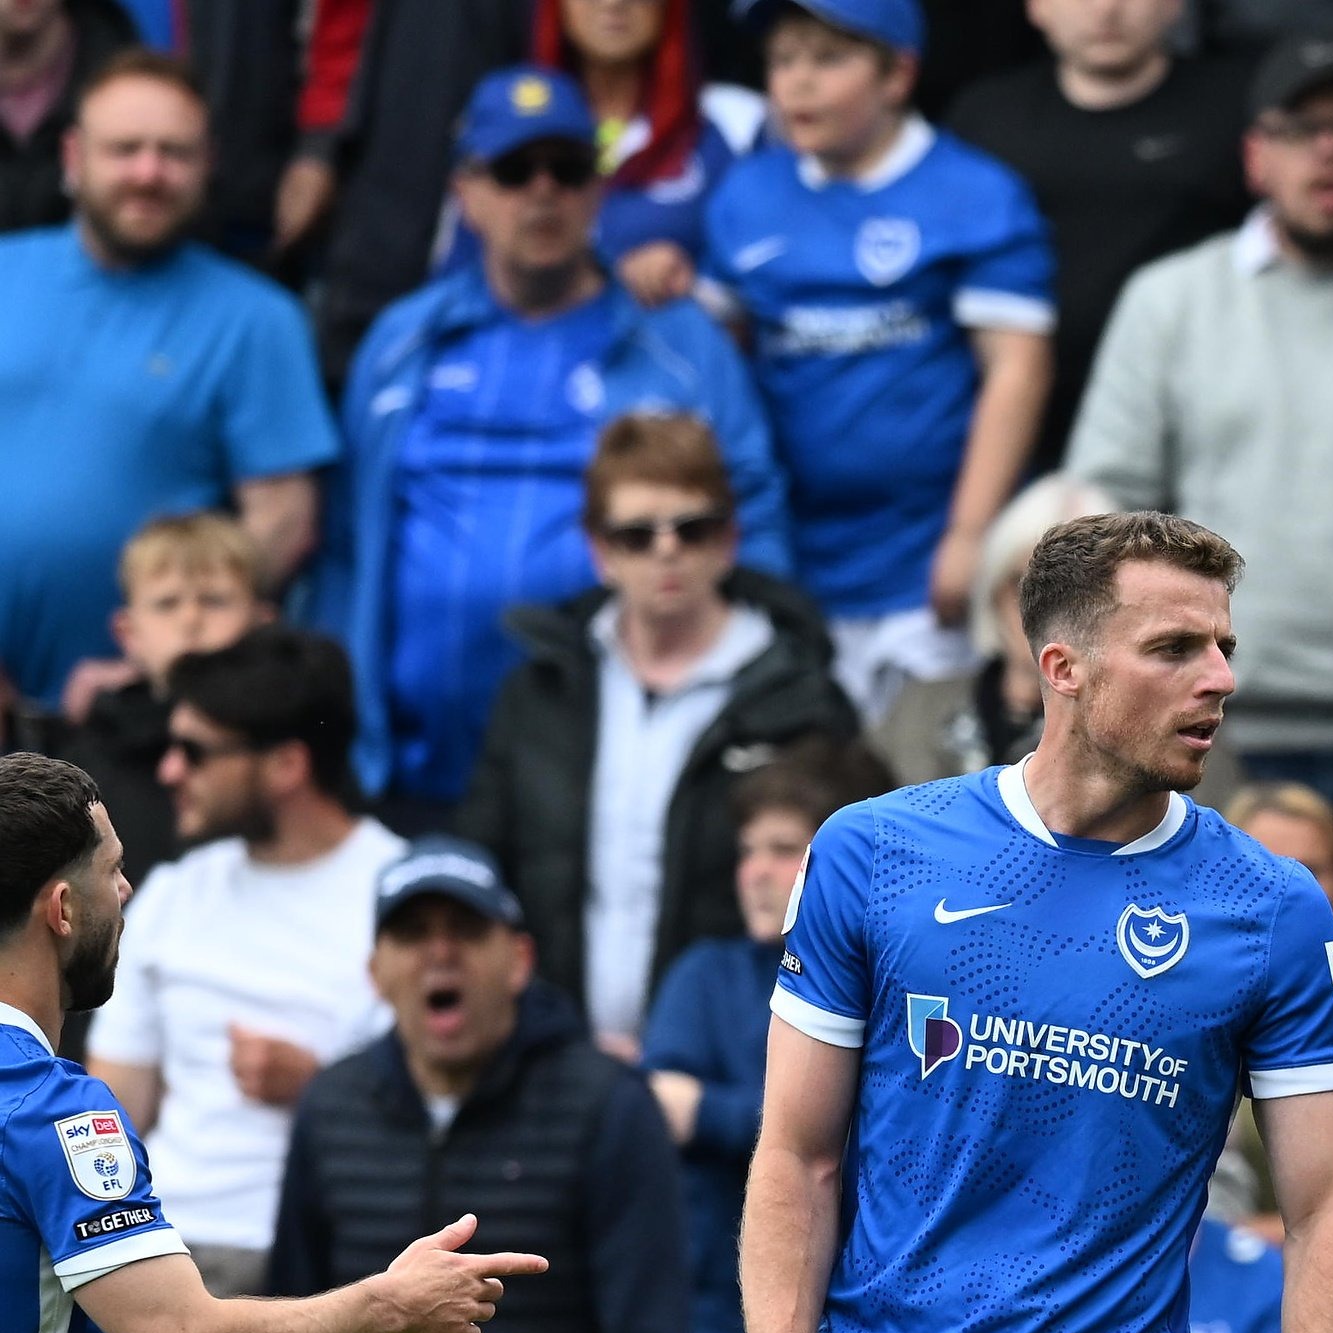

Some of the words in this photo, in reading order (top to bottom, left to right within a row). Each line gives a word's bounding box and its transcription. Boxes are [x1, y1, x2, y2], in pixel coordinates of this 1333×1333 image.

[969, 1013, 1164, 1071] UNIVERSITY
[1158, 1055, 1188, 1078] OF
[965, 1044, 1180, 1108] PORTSMOUTH
[66, 1123, 90, 1139] sky
[94, 1118, 117, 1132] bet
[102, 1179, 123, 1191] EFL
